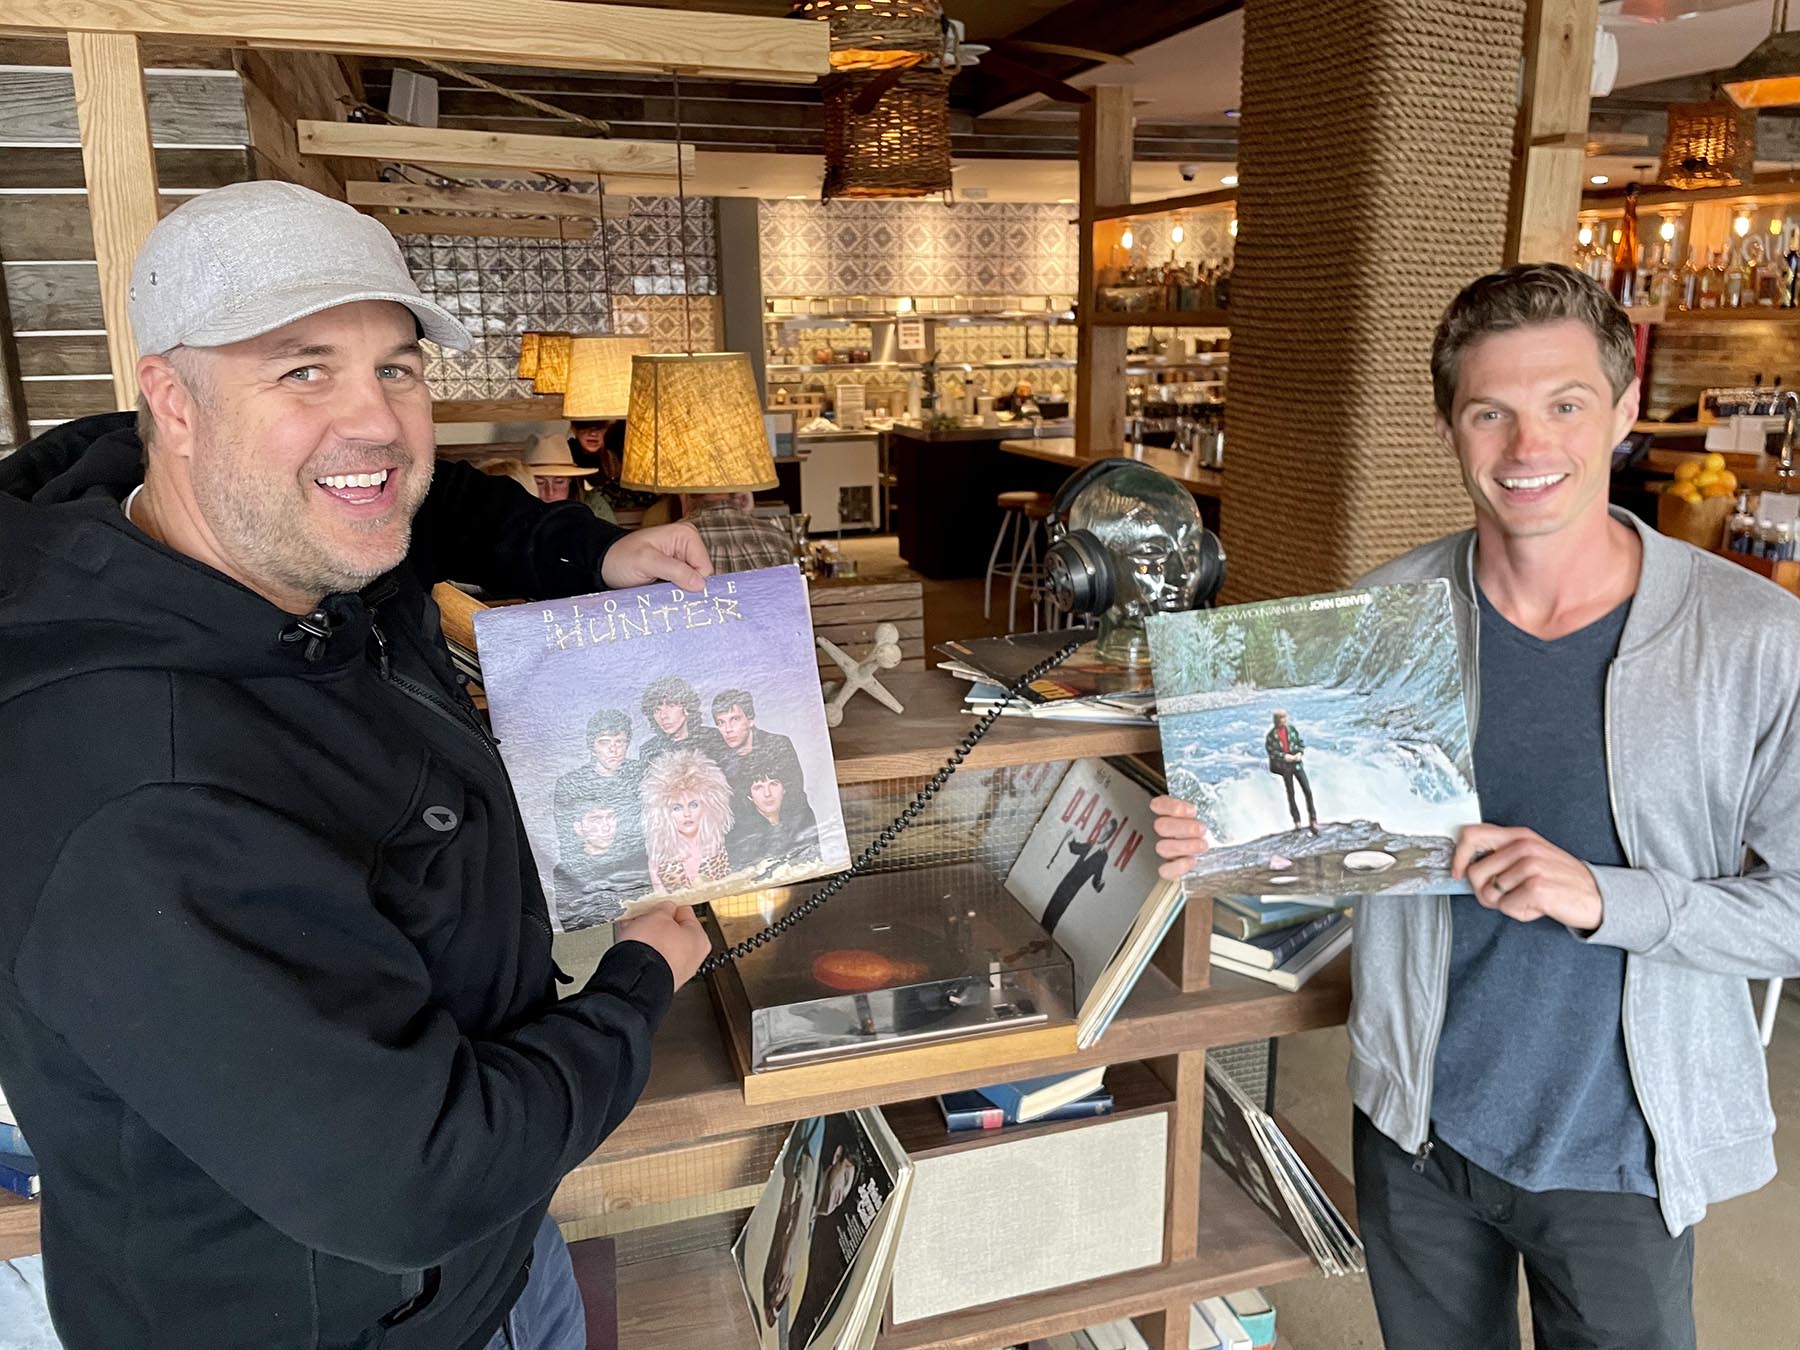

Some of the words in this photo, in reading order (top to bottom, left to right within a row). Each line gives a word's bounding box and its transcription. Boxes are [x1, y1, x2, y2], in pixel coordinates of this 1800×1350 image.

[542, 580, 737, 623] BLONDIE
[555, 596, 742, 650] HUNTER
[1309, 598, 1335, 612] JOHN
[1060, 787, 1144, 872] DARIN
